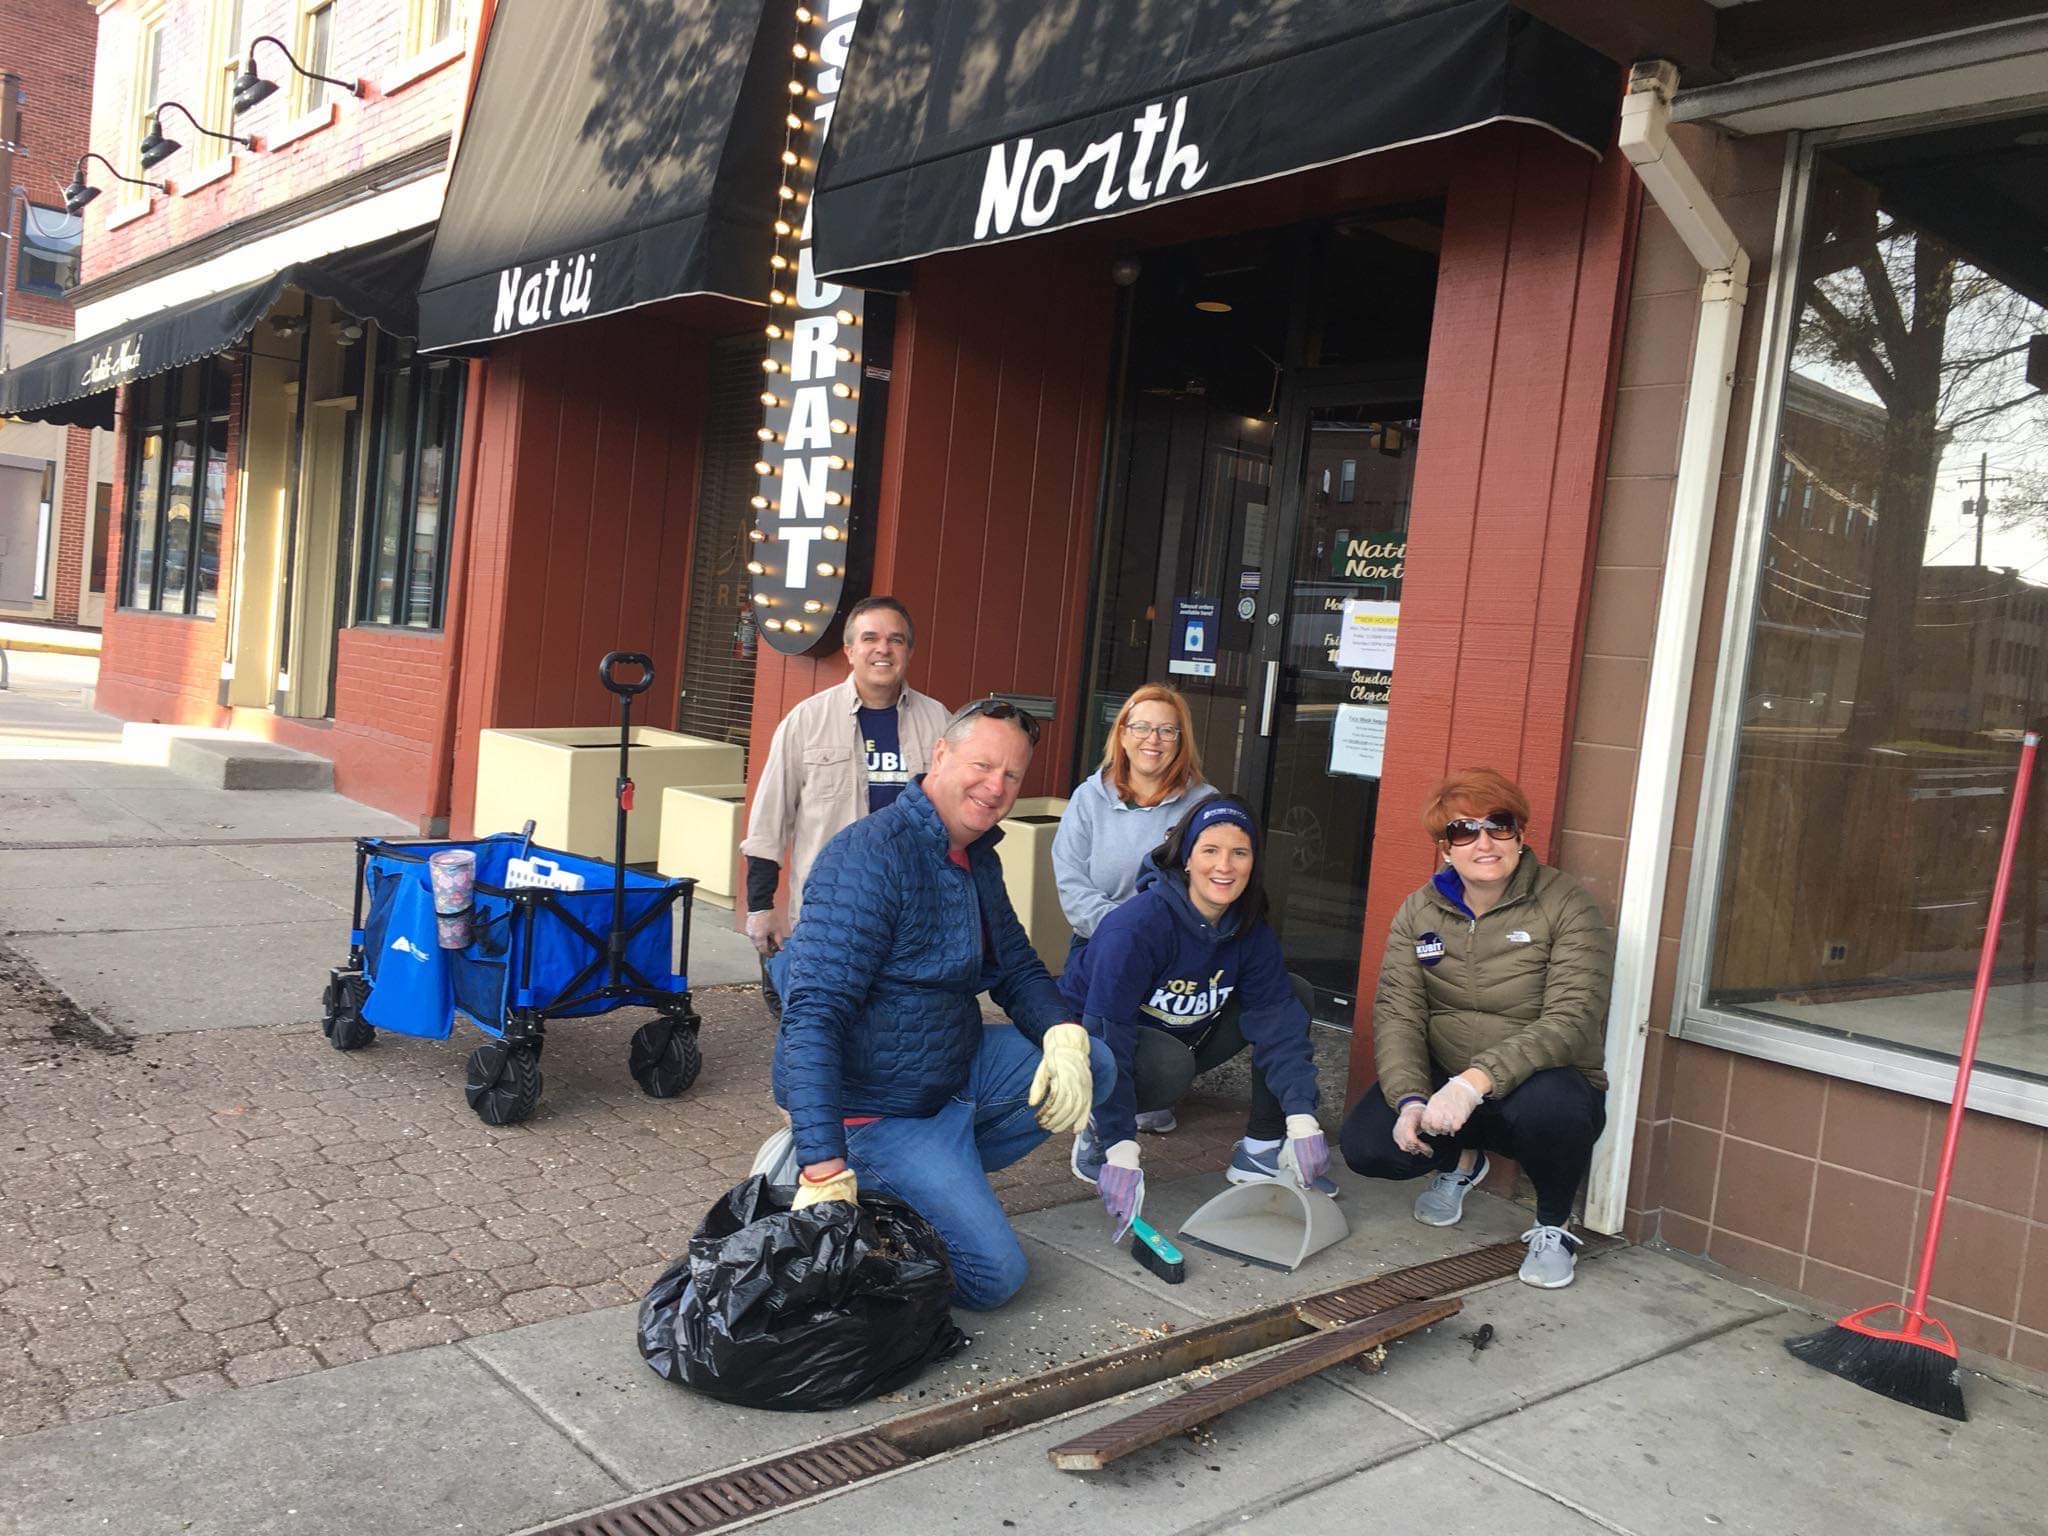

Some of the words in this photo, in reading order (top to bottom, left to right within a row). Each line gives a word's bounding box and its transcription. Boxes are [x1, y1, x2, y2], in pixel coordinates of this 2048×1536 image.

[973, 96, 1210, 240] North
[493, 253, 597, 333] Natili
[1350, 685, 1391, 702] Closed
[1148, 984, 1234, 1016] KUBIT
